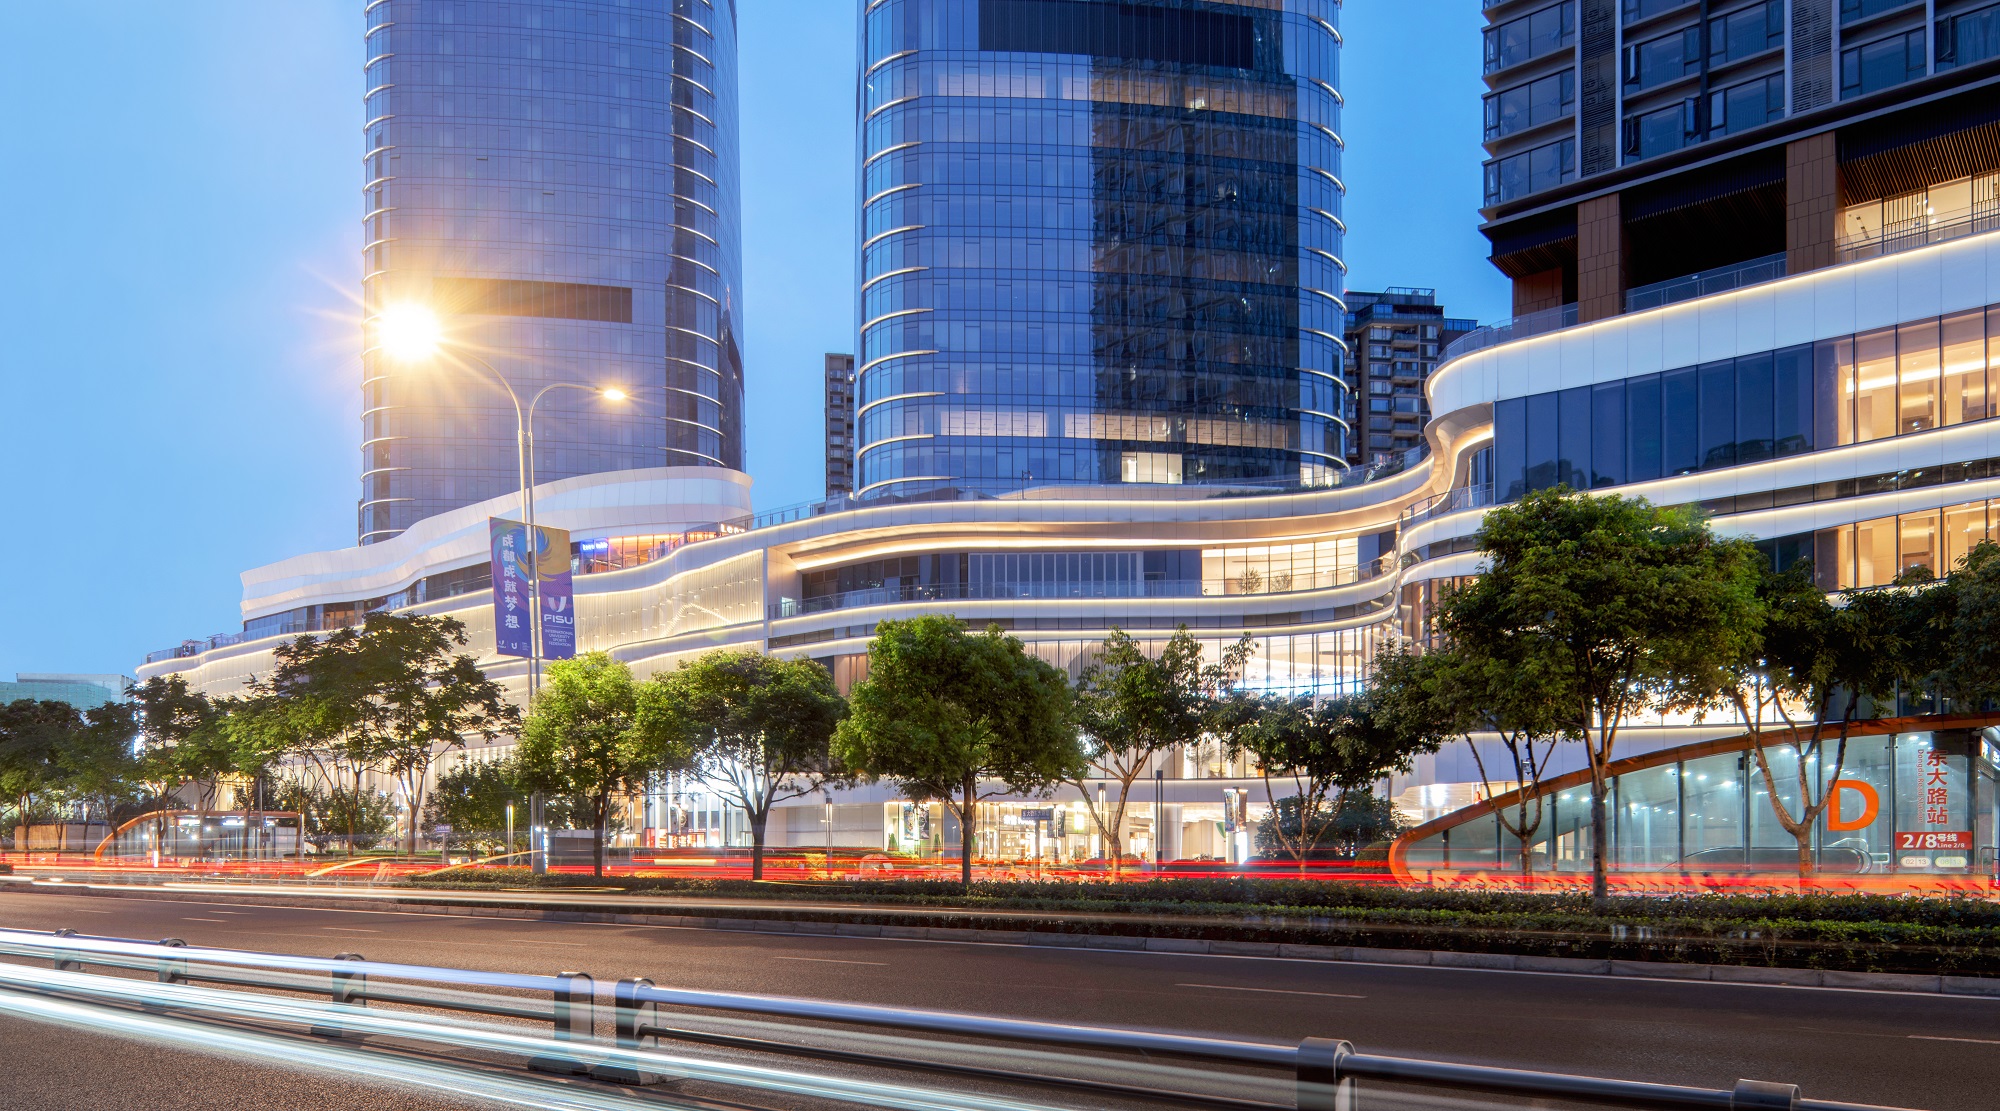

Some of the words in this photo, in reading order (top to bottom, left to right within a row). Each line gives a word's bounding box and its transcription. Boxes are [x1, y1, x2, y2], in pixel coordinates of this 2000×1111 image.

[502, 534, 520, 629] 成都成就梦想
[543, 614, 573, 625] FISU
[1827, 779, 1880, 831] D
[1926, 749, 1949, 825] 东大路站
